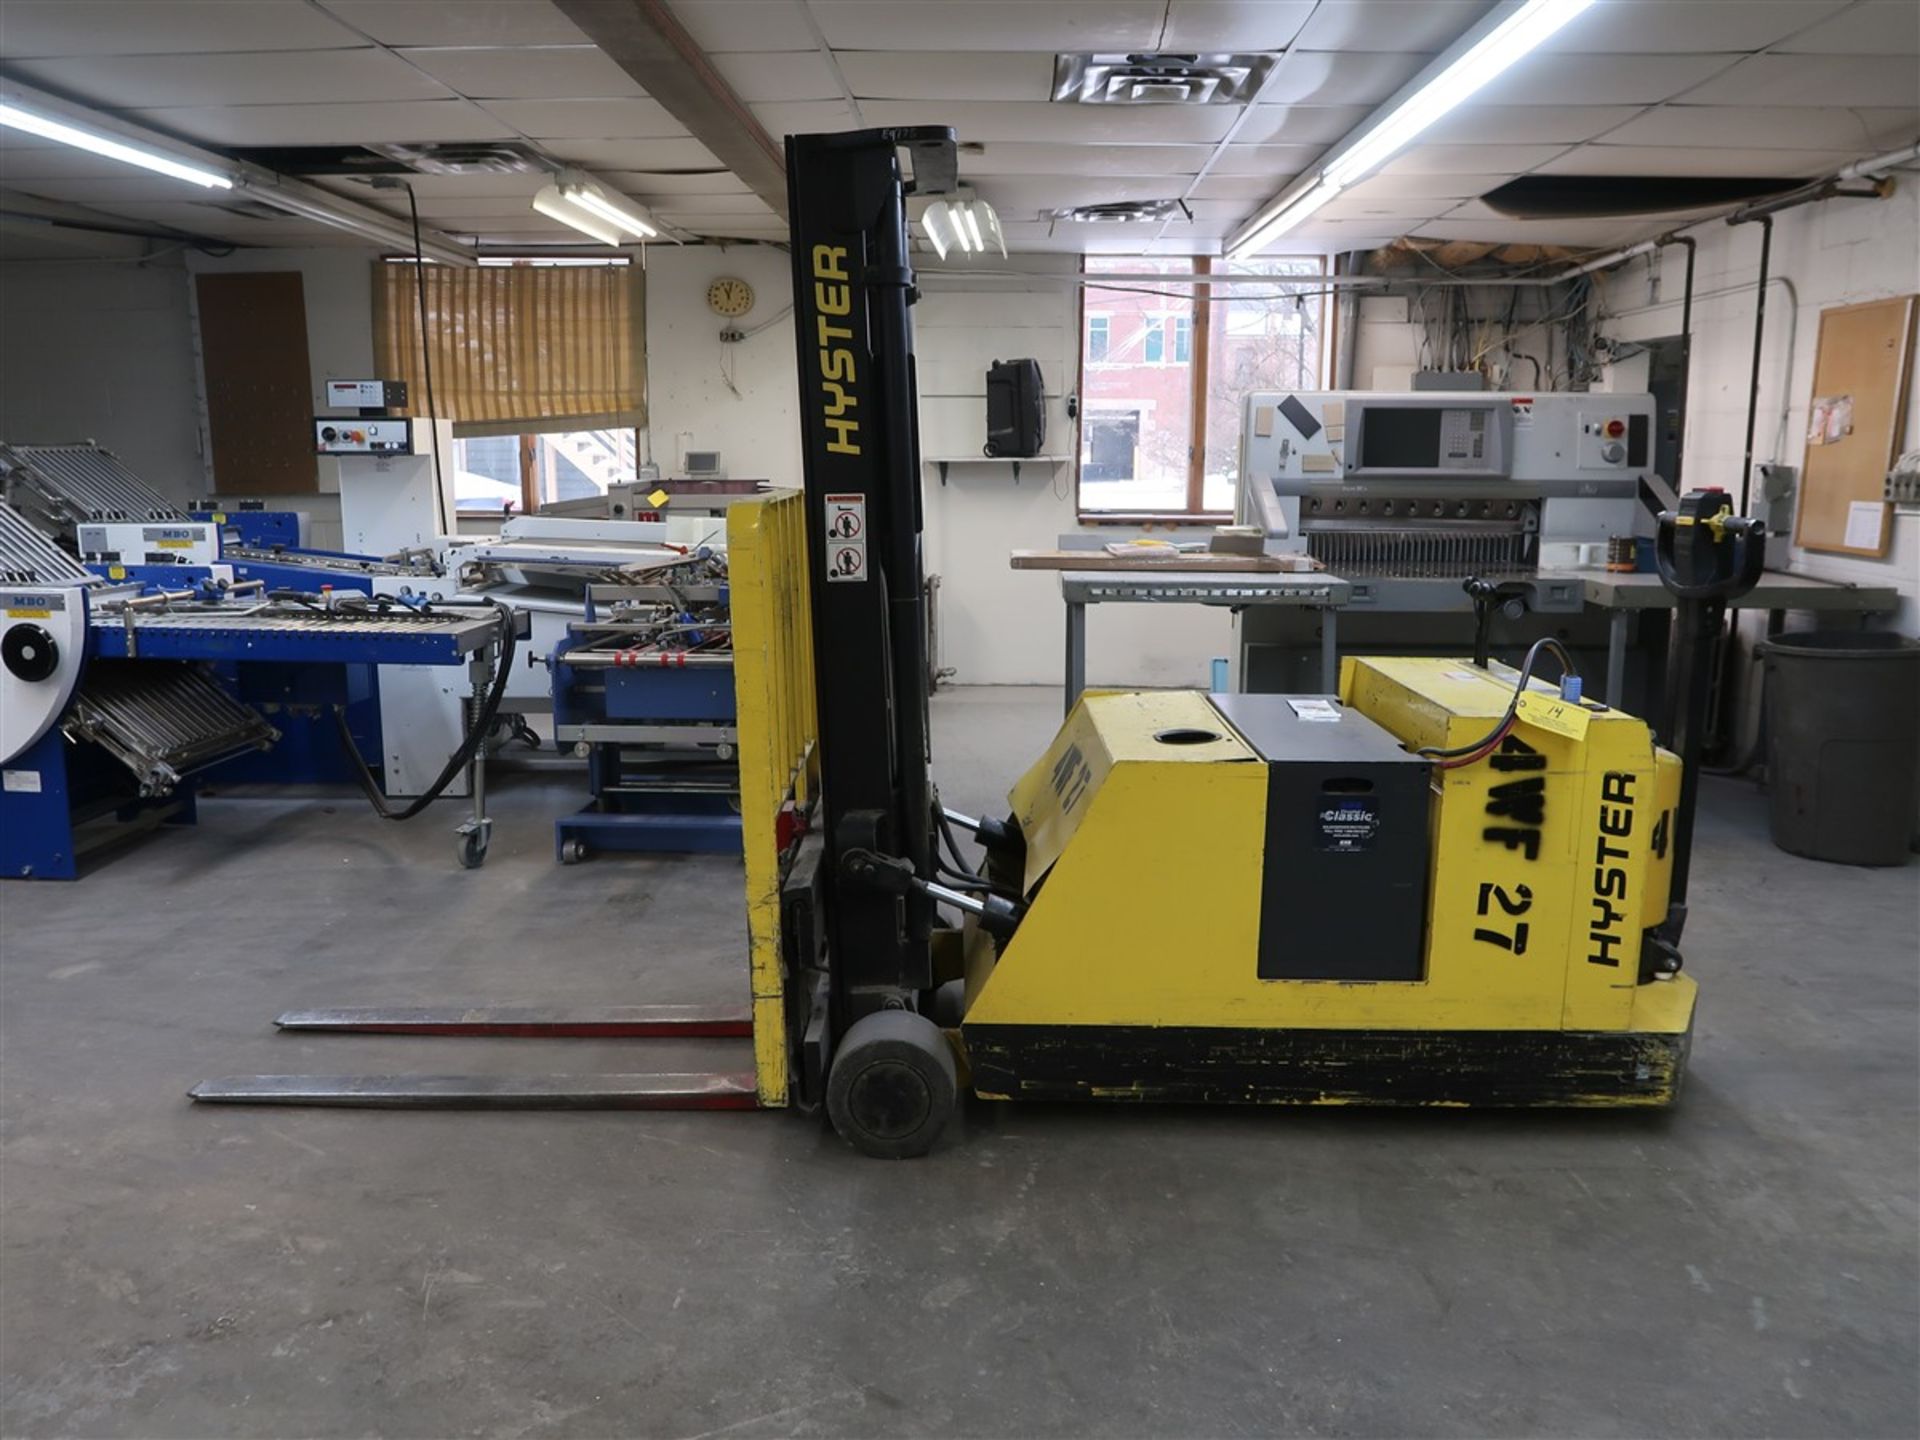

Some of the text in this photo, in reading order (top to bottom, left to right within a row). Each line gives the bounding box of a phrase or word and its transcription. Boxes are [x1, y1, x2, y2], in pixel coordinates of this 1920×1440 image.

[812, 243, 861, 455] HYSTER
[162, 530, 190, 538] MBO
[13, 596, 46, 606] MBO
[1546, 706, 1565, 719] 14
[1324, 810, 1373, 822] Classic
[1474, 734, 1545, 956] 4WF 27
[1587, 771, 1637, 968] HYSTER
